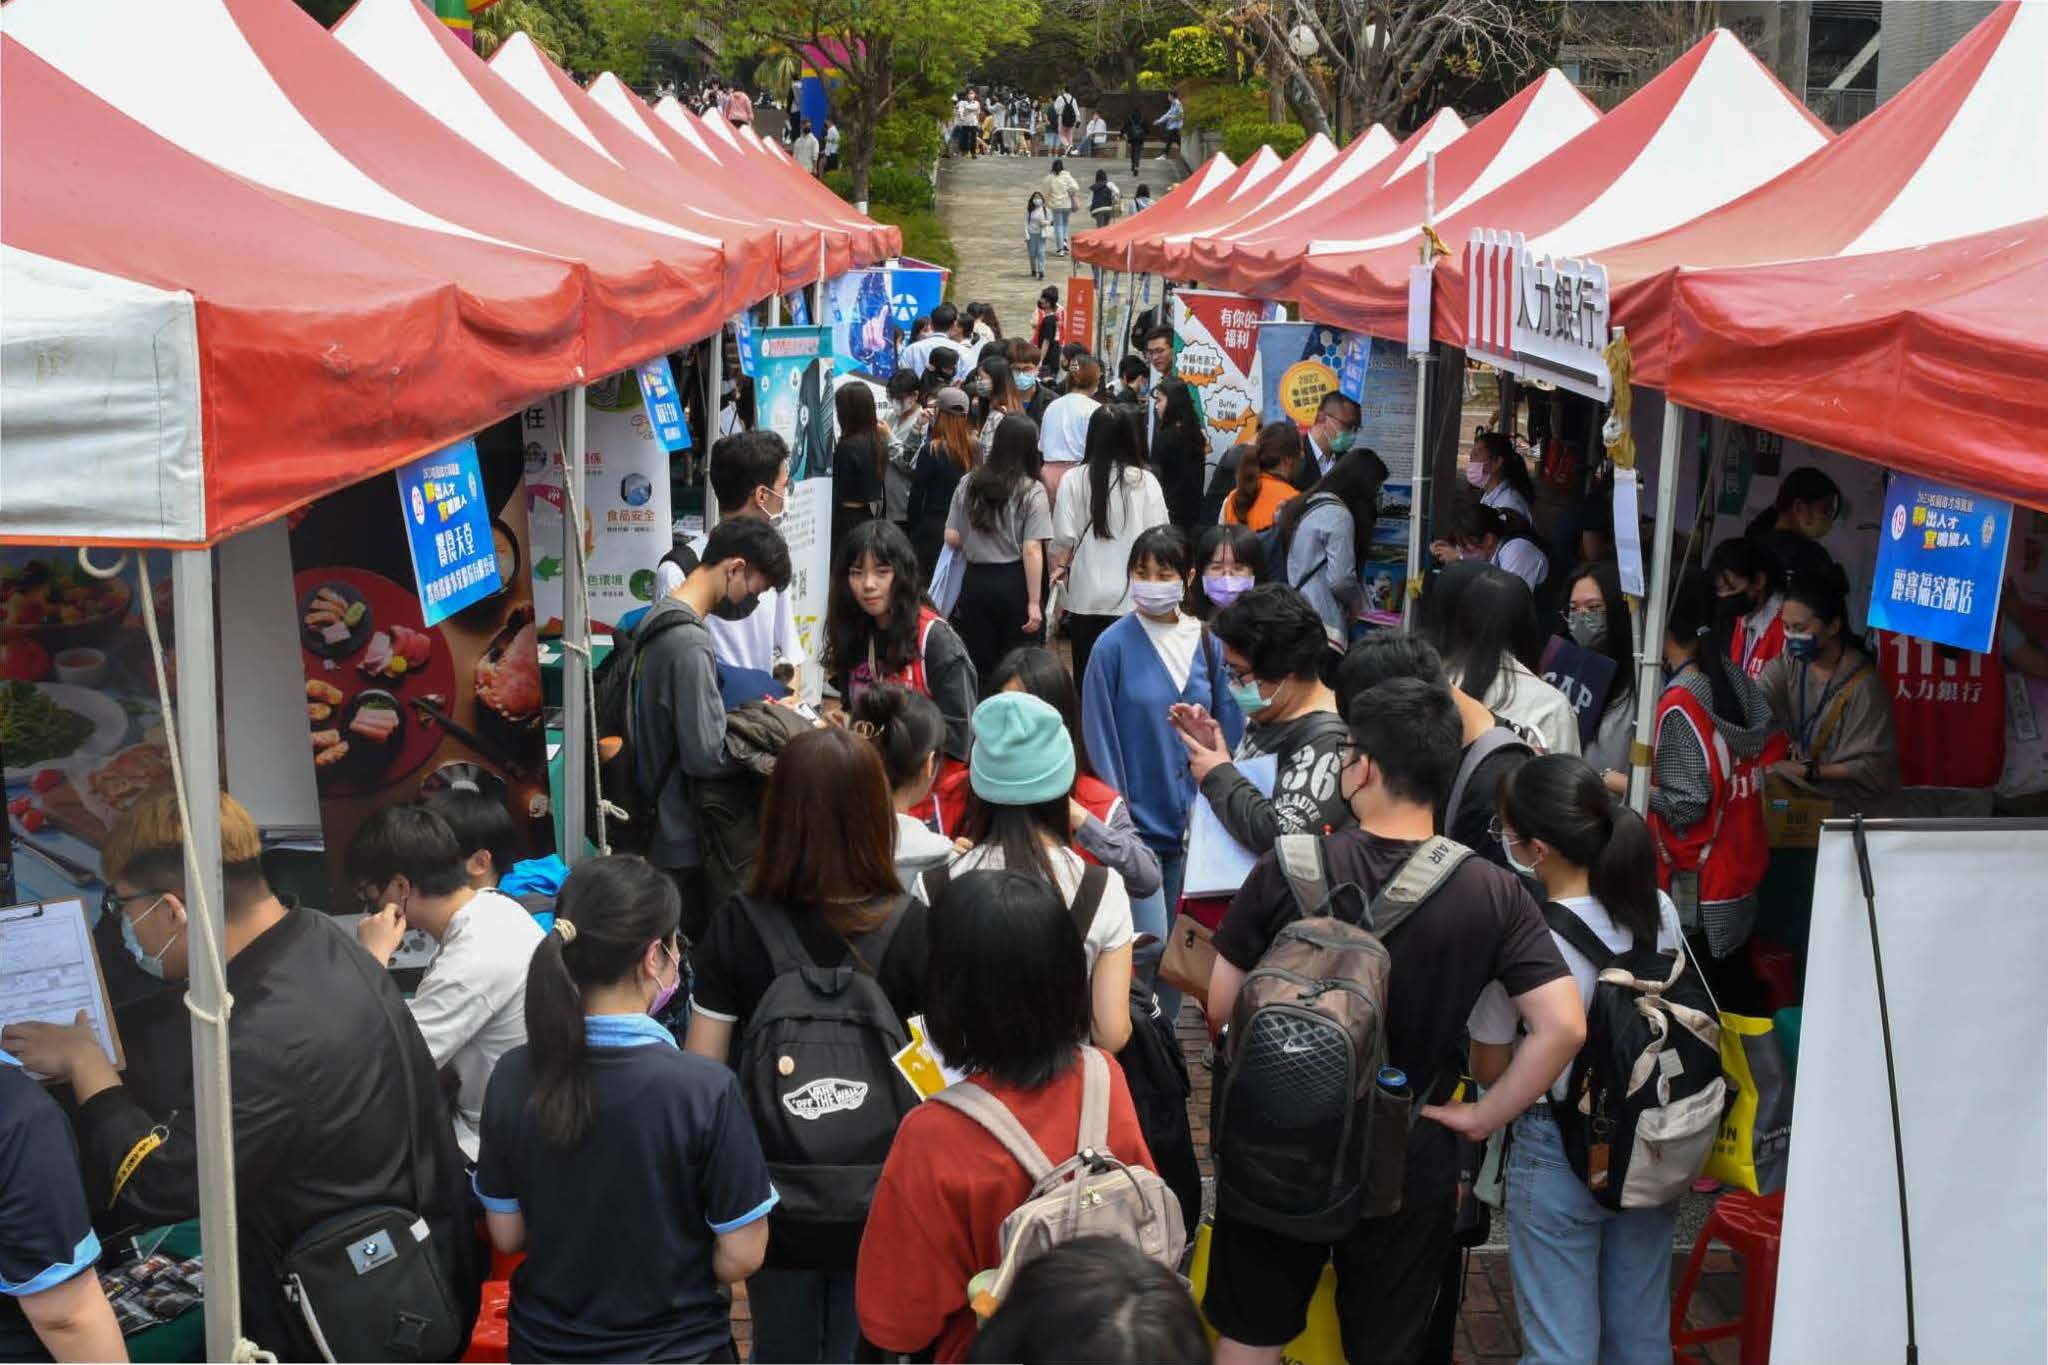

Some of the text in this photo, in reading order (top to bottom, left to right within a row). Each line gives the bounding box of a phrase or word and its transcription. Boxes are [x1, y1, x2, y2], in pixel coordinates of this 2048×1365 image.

[1221, 307, 1258, 329] 有你的
[1516, 264, 1603, 349] 人力銀行
[1224, 328, 1250, 350] 福利
[607, 509, 656, 523] 食品安全
[1891, 568, 1976, 615] 麗寶福容飯店
[1894, 679, 1985, 703] 人力銀行
[1281, 744, 1341, 802] 36
[1428, 843, 1449, 865] AIR
